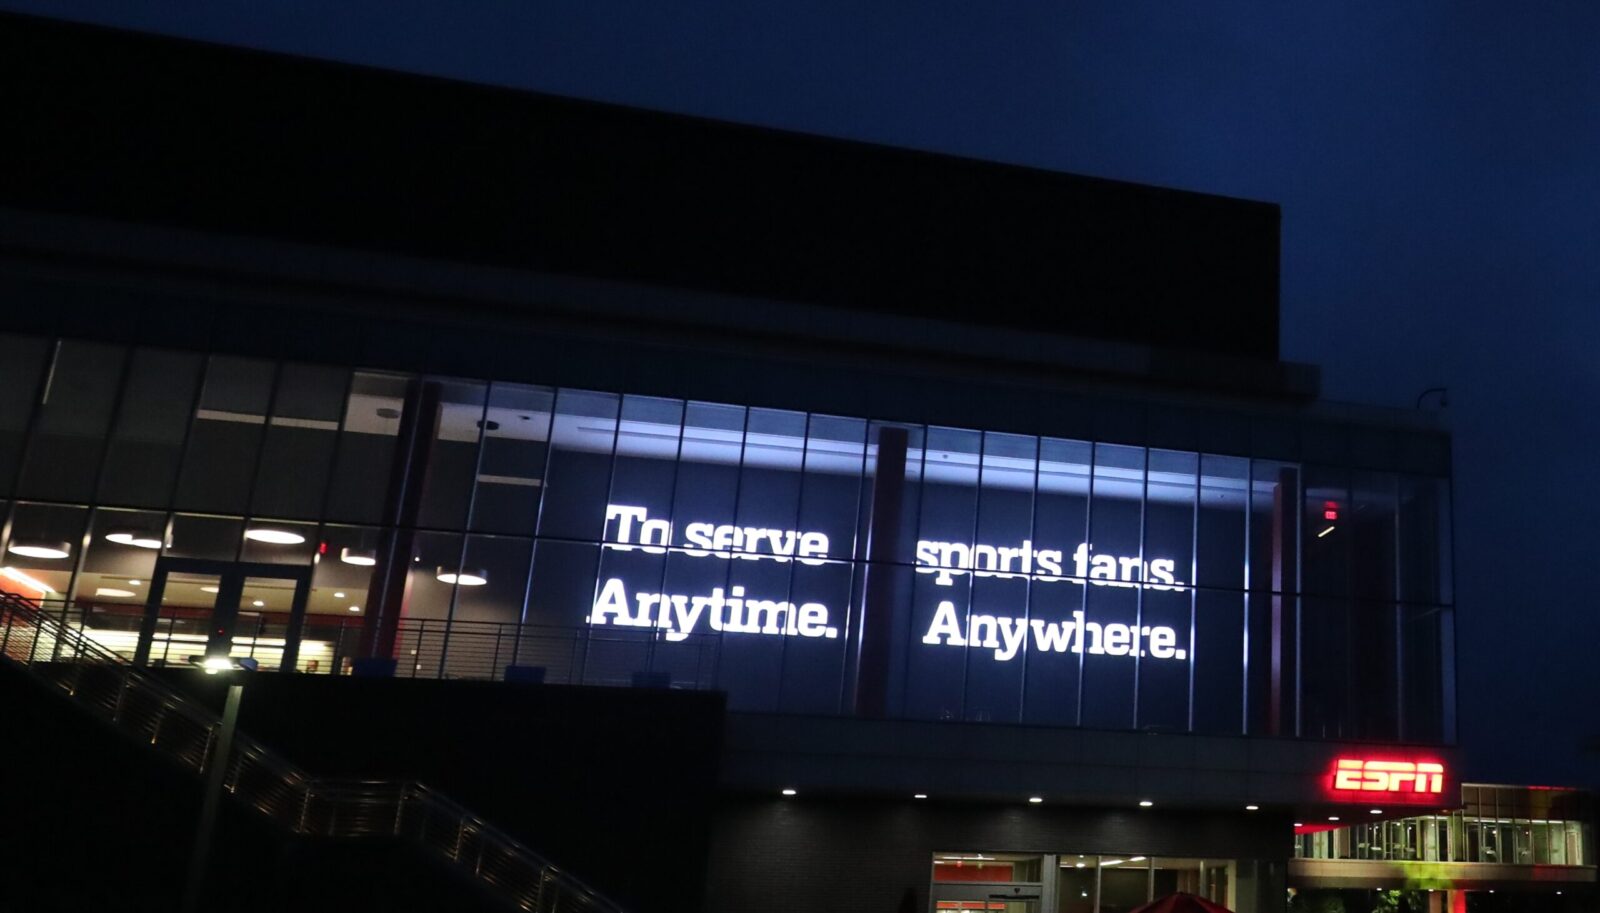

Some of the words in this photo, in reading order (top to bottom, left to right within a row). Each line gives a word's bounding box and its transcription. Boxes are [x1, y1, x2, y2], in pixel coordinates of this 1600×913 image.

[604, 504, 673, 554] To
[685, 522, 830, 566] serve
[914, 540, 1063, 586] sports
[1073, 542, 1185, 592] fans.
[586, 578, 838, 641] Anytime.
[922, 600, 1187, 661] Anywhere.
[1334, 758, 1444, 794] ESPN
